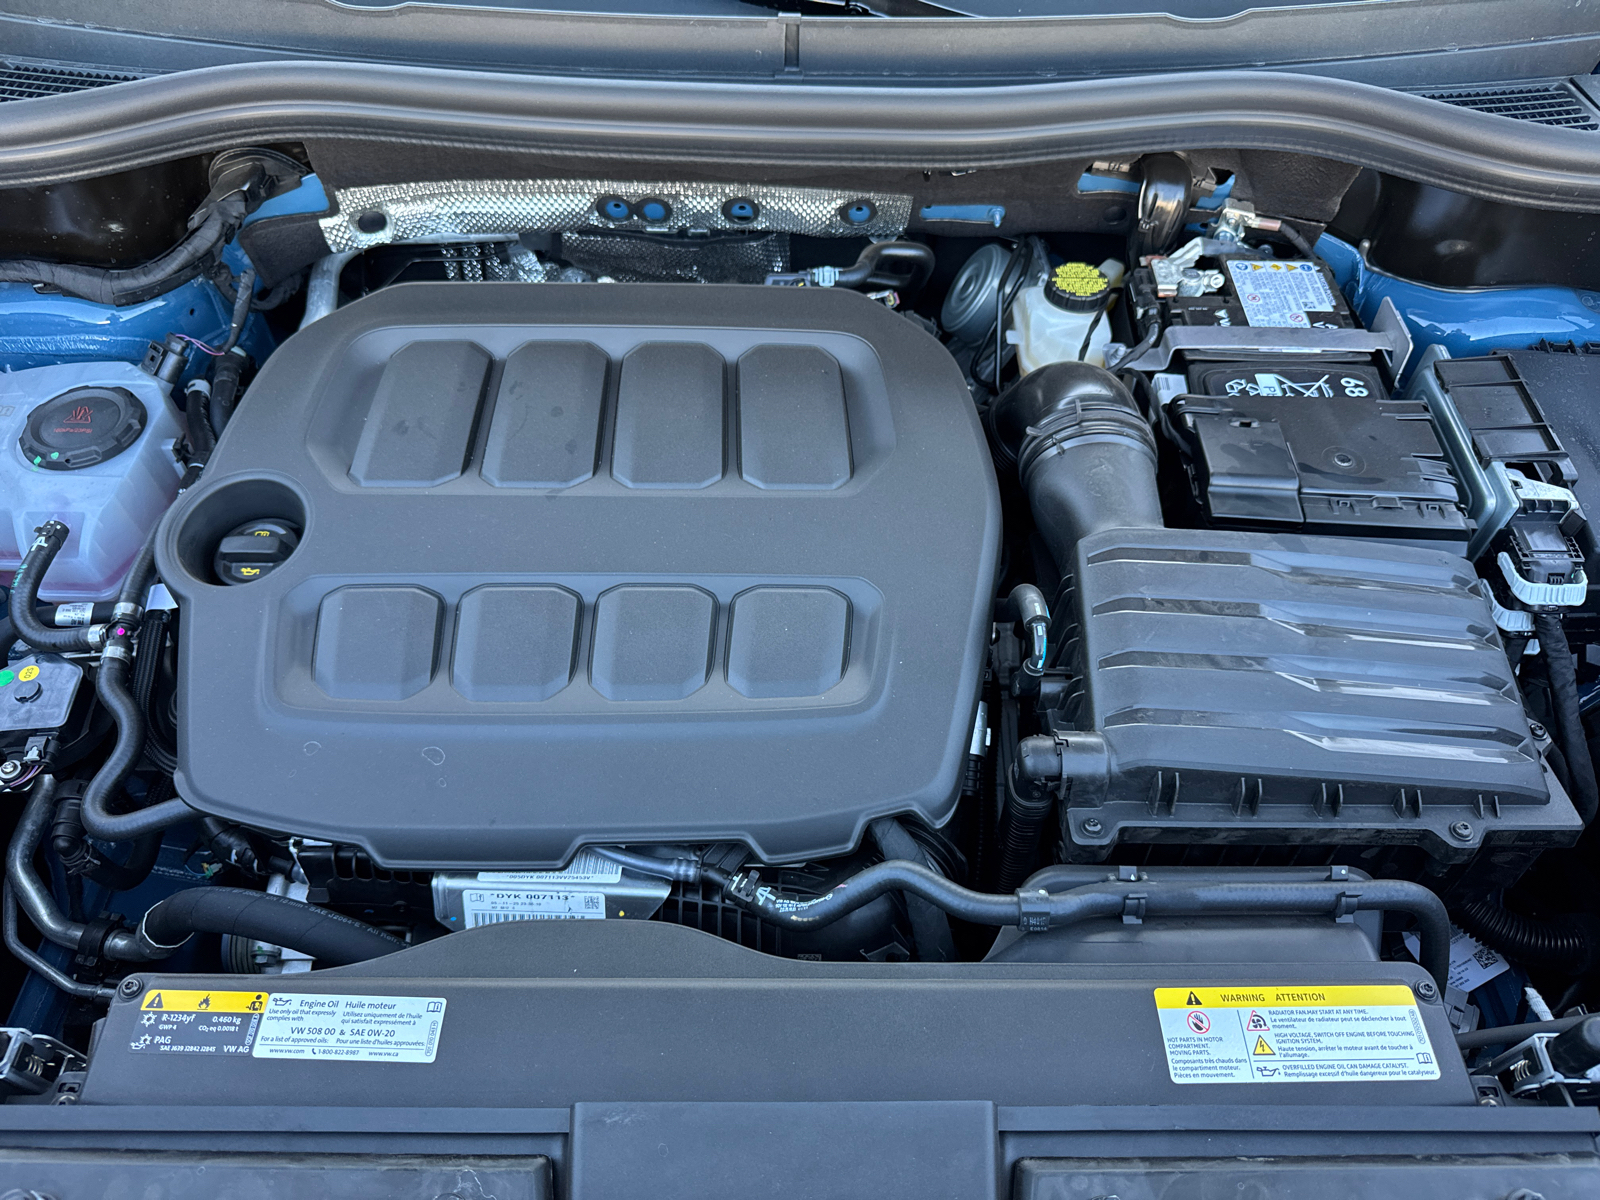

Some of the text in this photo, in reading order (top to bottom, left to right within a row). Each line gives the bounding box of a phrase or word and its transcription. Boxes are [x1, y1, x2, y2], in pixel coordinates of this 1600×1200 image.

[1220, 993, 1326, 1002] WARNING ATTENTION
[300, 1000, 326, 1009] Engine
[328, 1000, 340, 1008] Oil
[161, 1013, 242, 1025] R-1234yf 0.460 kg
[350, 1028, 366, 1036] SAE
[153, 1036, 172, 1044] PAG
